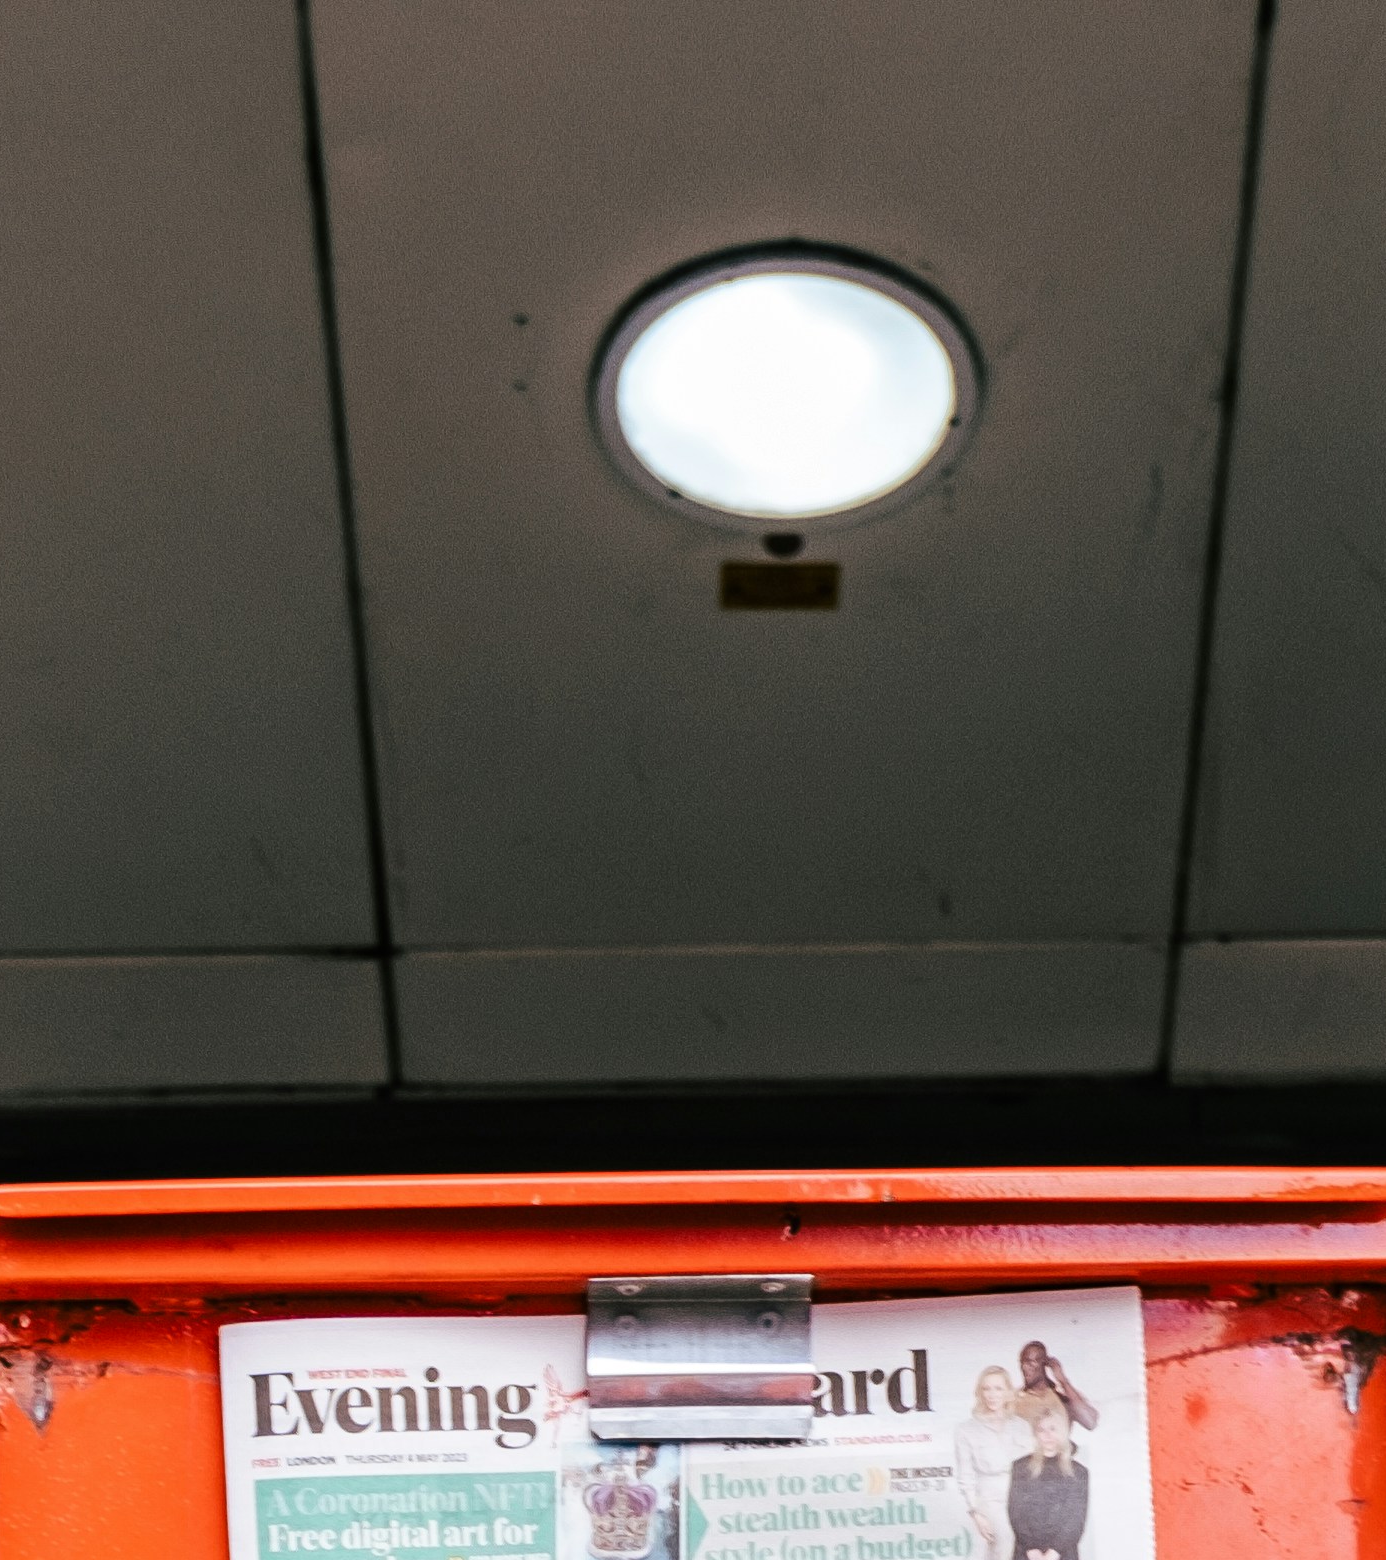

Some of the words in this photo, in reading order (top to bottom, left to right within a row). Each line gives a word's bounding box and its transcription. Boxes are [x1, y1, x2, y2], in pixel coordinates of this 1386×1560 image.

[249, 1366, 538, 1450] Evening
[266, 1489, 291, 1516] A
[295, 1485, 469, 1516] Coronation
[700, 1472, 771, 1501] How
[776, 1474, 806, 1496] to
[812, 1471, 863, 1496] ace
[718, 1504, 821, 1534] stealth
[825, 1498, 928, 1528] wealth
[268, 1523, 338, 1552] Free
[341, 1519, 441, 1556] digital
[443, 1522, 489, 1548] art
[493, 1517, 539, 1546] for
